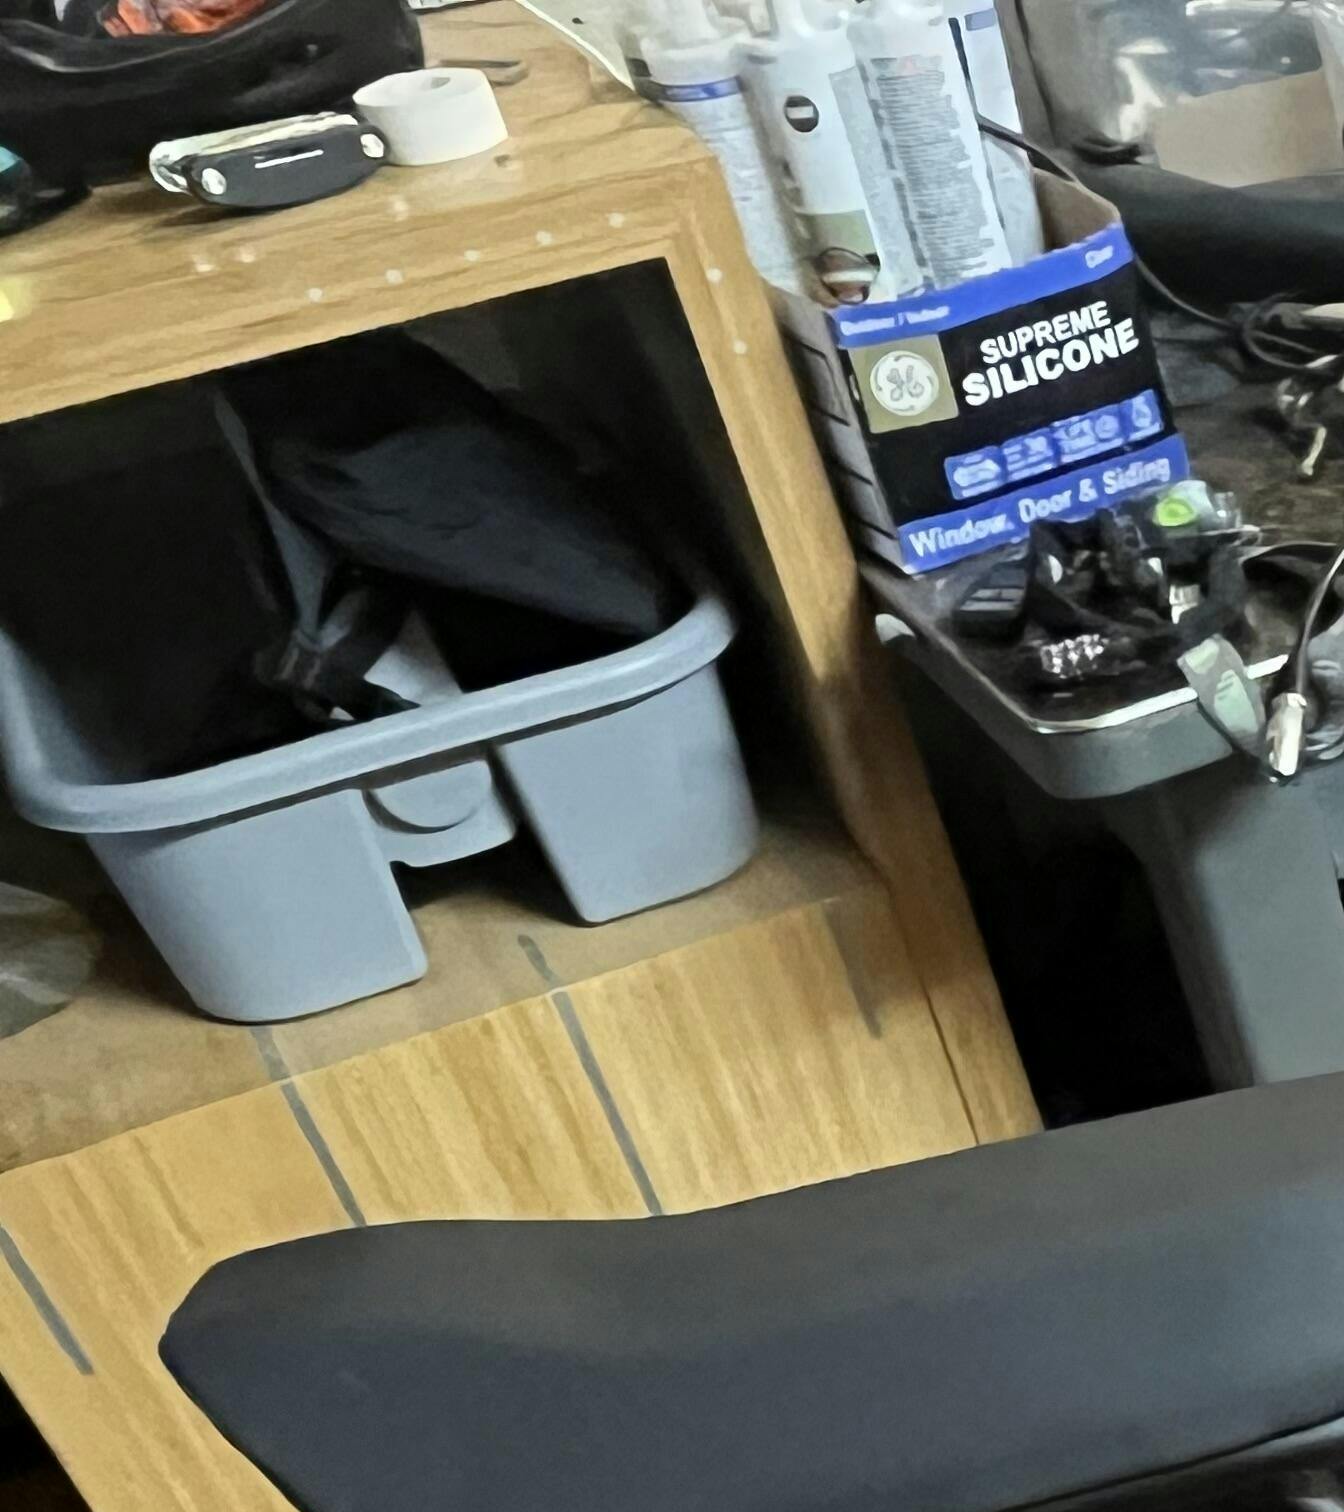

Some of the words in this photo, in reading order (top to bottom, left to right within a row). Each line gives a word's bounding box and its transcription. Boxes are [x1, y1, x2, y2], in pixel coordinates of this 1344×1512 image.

[962, 318, 1139, 406] SILICONE
[979, 301, 1111, 364] SUPREME
[1018, 489, 1072, 524] Door
[1078, 477, 1099, 502] &
[1102, 457, 1171, 495] Siding
